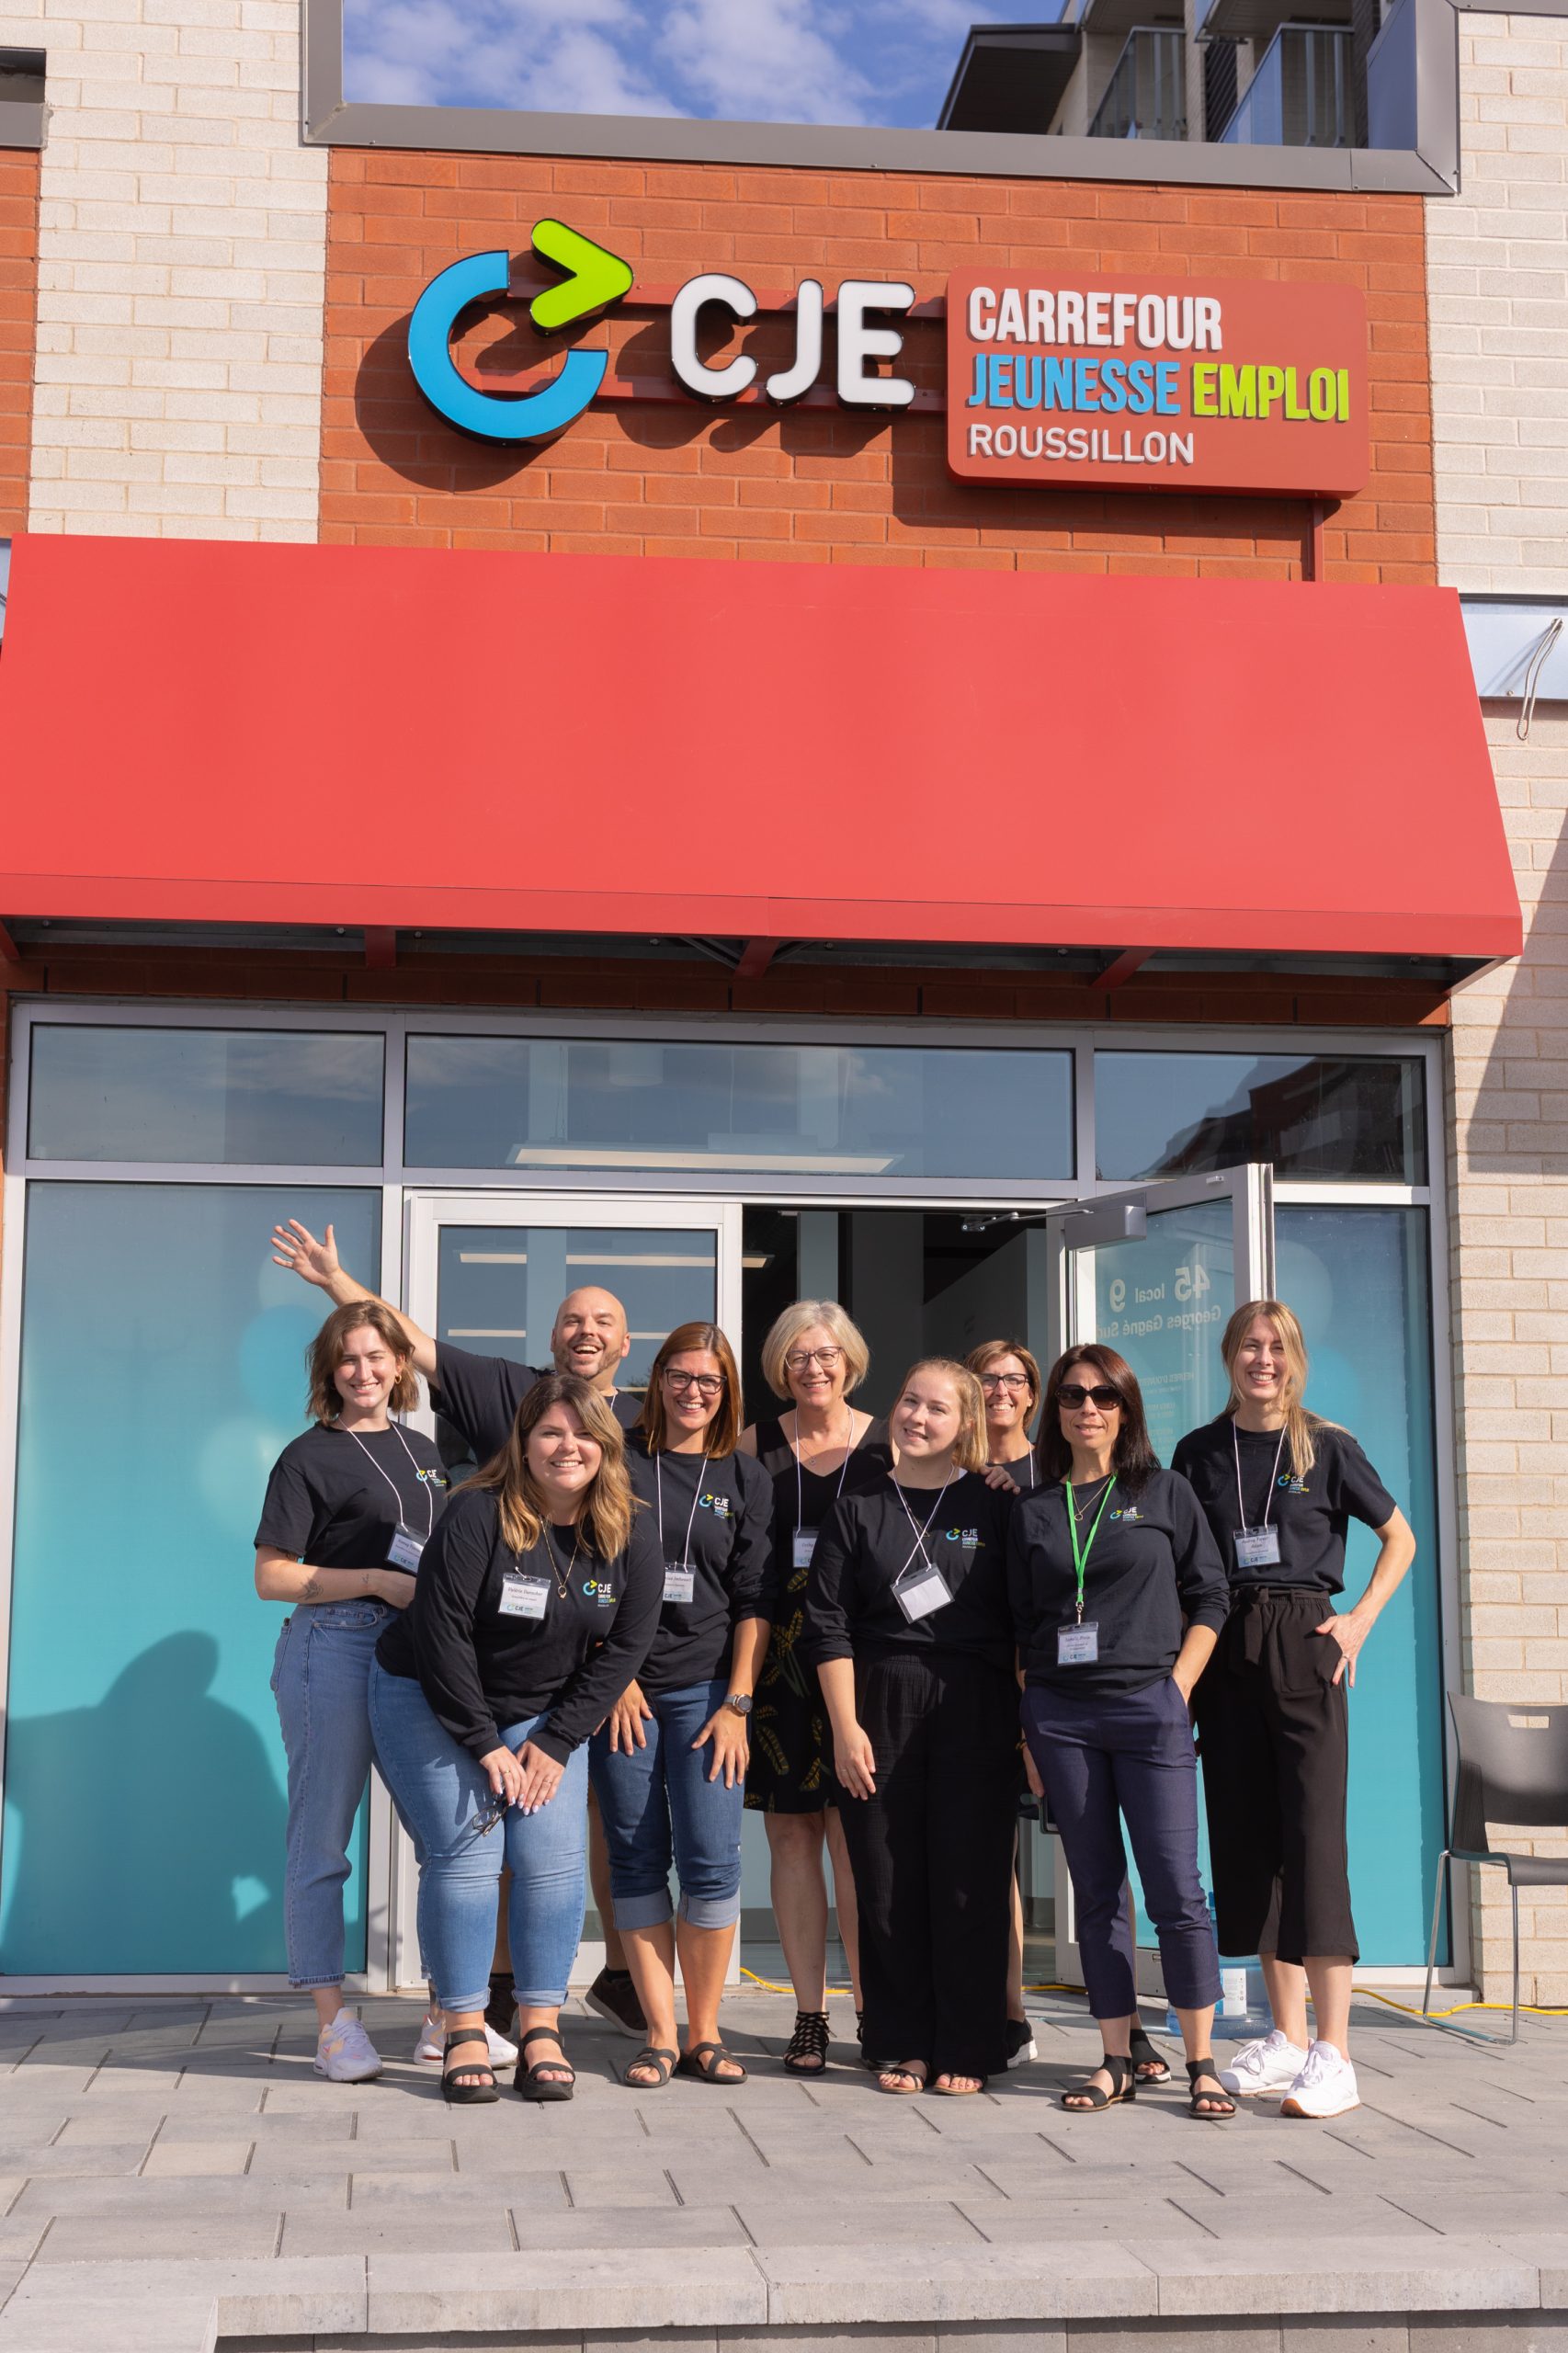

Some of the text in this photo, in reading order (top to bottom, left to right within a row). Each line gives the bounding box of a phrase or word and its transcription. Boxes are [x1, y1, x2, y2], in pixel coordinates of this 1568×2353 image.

[968, 286, 1222, 350] CARREFOUR
[671, 273, 916, 406] CJE
[968, 353, 1349, 421] JEUNESSE EMPLOI
[969, 423, 1194, 464] ROUSSILLON
[714, 1496, 729, 1507] CJE
[961, 1529, 978, 1537] CJE
[597, 1583, 612, 1594] CJE
